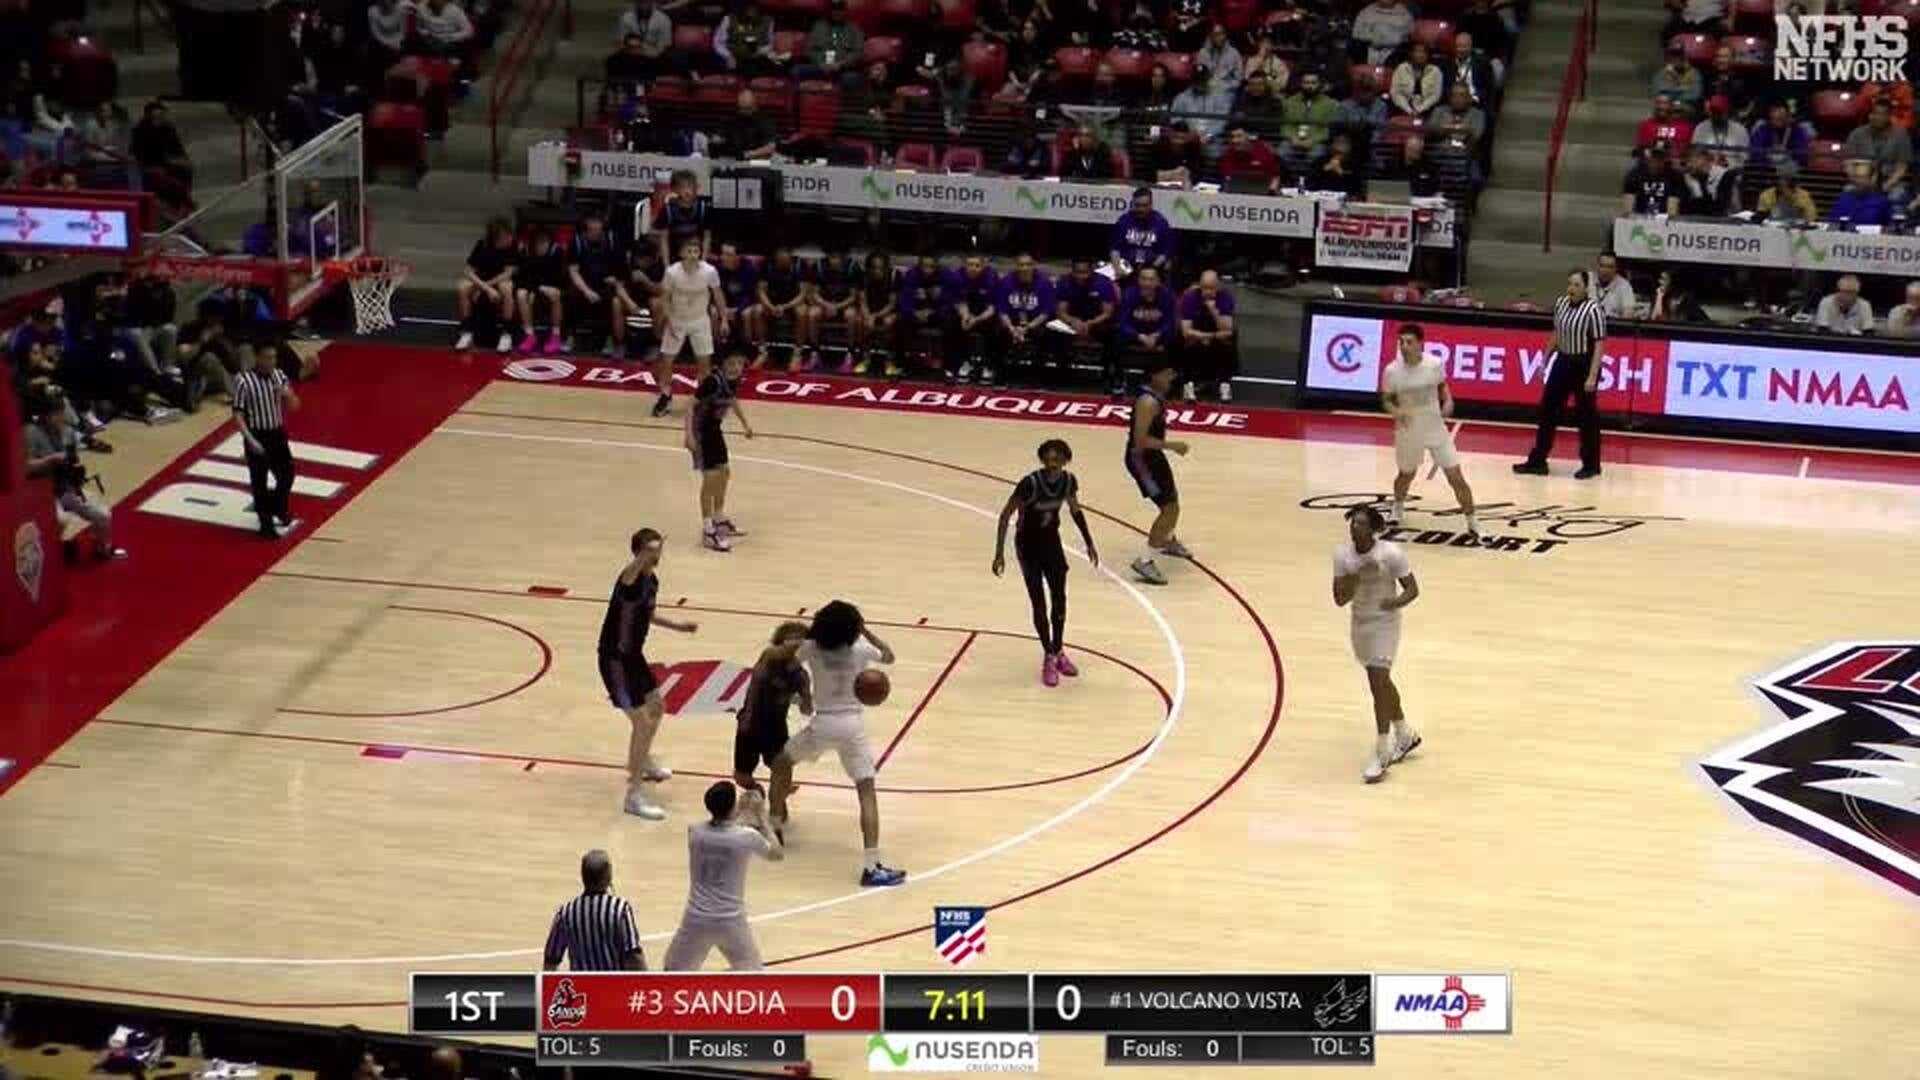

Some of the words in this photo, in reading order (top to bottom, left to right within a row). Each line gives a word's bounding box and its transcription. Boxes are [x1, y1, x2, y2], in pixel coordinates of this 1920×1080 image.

[896, 182, 985, 203] NUSENDA
[1051, 192, 1132, 212] NUSEND
[1208, 204, 1299, 225] NUSENDA
[1667, 235, 1761, 253] NUSENDA
[1420, 339, 1506, 383] REE
[1518, 346, 1654, 394] WSH
[1676, 361, 1756, 400] TXT
[1768, 367, 1909, 411] NMAA
[756, 380, 832, 396] OF
